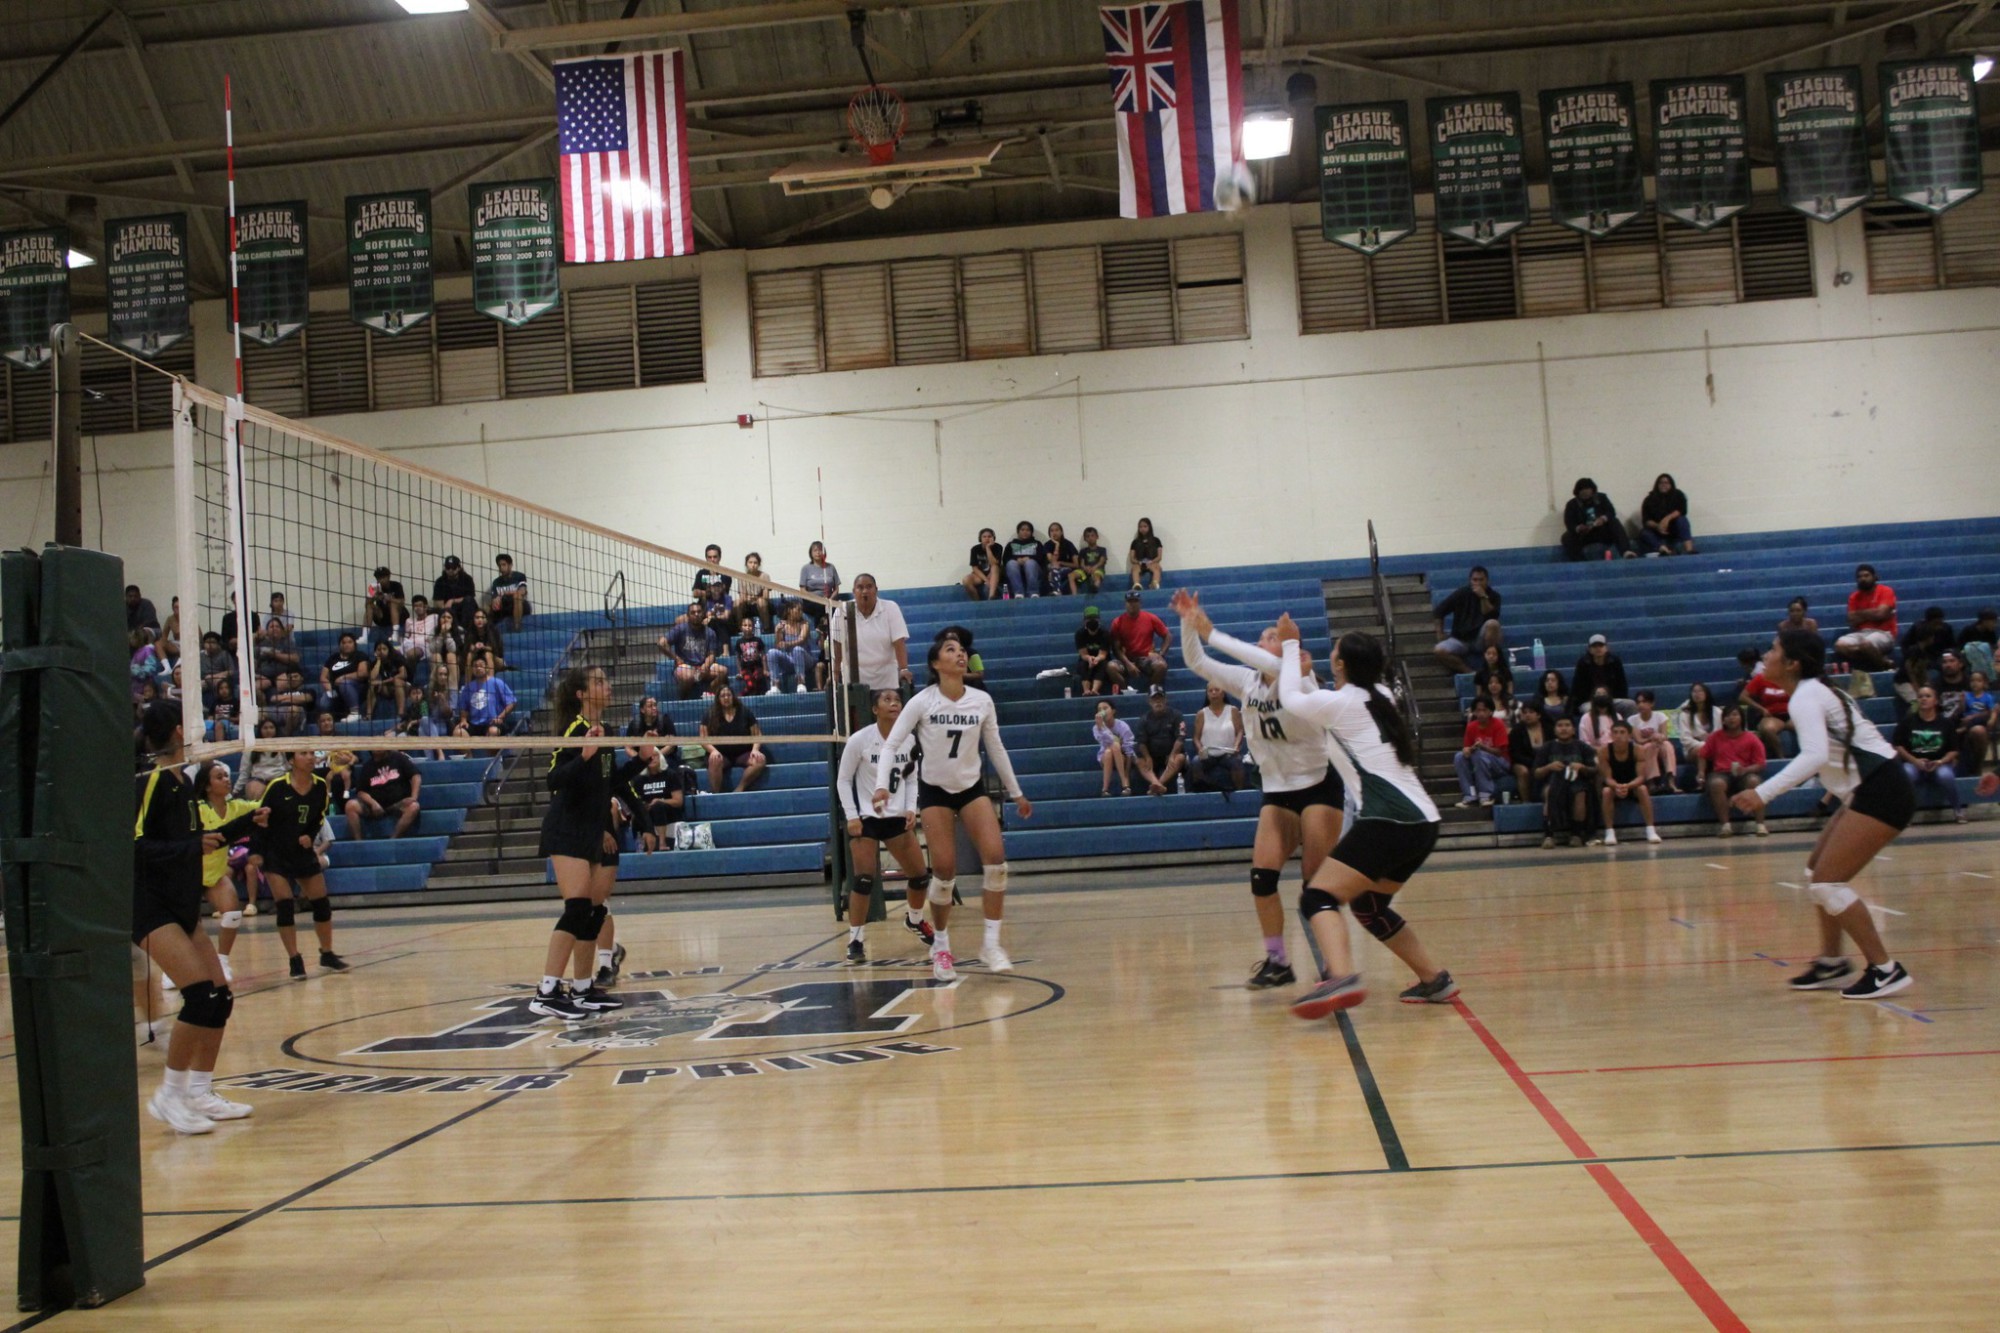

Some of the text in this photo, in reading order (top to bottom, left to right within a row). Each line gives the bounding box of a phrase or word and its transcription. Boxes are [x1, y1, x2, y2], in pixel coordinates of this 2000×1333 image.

[1897, 68, 1957, 84] LEAGUE
[1669, 86, 1728, 102] LEAGUE
[1784, 78, 1843, 95] LEAGUE
[1890, 82, 1968, 107] CHAMPIONS
[1558, 94, 1616, 111] LEAGUE
[1777, 92, 1855, 117] CHAMPIONS
[1445, 103, 1503, 120] LEAGUE
[1660, 101, 1738, 125] CHAMPIONS
[1333, 112, 1391, 129] LEAGUE
[1551, 108, 1628, 133] CHAMPIONS
[1778, 122, 1803, 131] BOYS
[1438, 117, 1514, 142] CHAMPIONS
[1659, 126, 1741, 138] BOYS VOLLEYBALL
[1325, 126, 1401, 150] CHAMPIONS
[1549, 133, 1632, 148] BOYS BASKETBALL
[1322, 150, 1405, 164] BOYS AIR RIFLERY
[1450, 143, 1504, 155] BASEBALL
[485, 189, 539, 205] LEAGUE
[361, 201, 414, 217] LEAGUE
[477, 202, 549, 226] CHAMPIONS
[241, 211, 292, 228] LEAGUE
[355, 214, 424, 238] CHAMPIONS
[120, 224, 171, 240] LEAGUE
[235, 225, 300, 249] CHAMPIONS
[475, 226, 552, 239] GIRLS VOLLEYBALL
[5, 237, 55, 253] LEAGUE
[113, 237, 180, 261] CHAMPIONS
[365, 239, 414, 250] SOFTBALL
[0, 250, 63, 274] CHAMPIONS
[251, 251, 271, 260] CANOE
[273, 248, 304, 258] PADDLING
[536, 250, 553, 258] 2010
[109, 260, 185, 275] GIRLS BASKETBALL
[392, 263, 410, 271] 2013
[413, 261, 429, 269] 2014
[0, 272, 67, 287] IRLS AIR RIFLERY
[354, 279, 370, 287] 2017
[393, 275, 411, 283] 2019
[0, 289, 11, 298] 010
[131, 299, 147, 307] 2011
[149, 297, 167, 305] 2013
[169, 295, 185, 304] 2014
[930, 714, 979, 725] MOLOKAI
[947, 729, 963, 758] 7
[871, 752, 909, 764] MKAI
[889, 767, 902, 794] 6
[298, 804, 309, 824] 7
[212, 1040, 962, 1093] FARMER PRIDE
